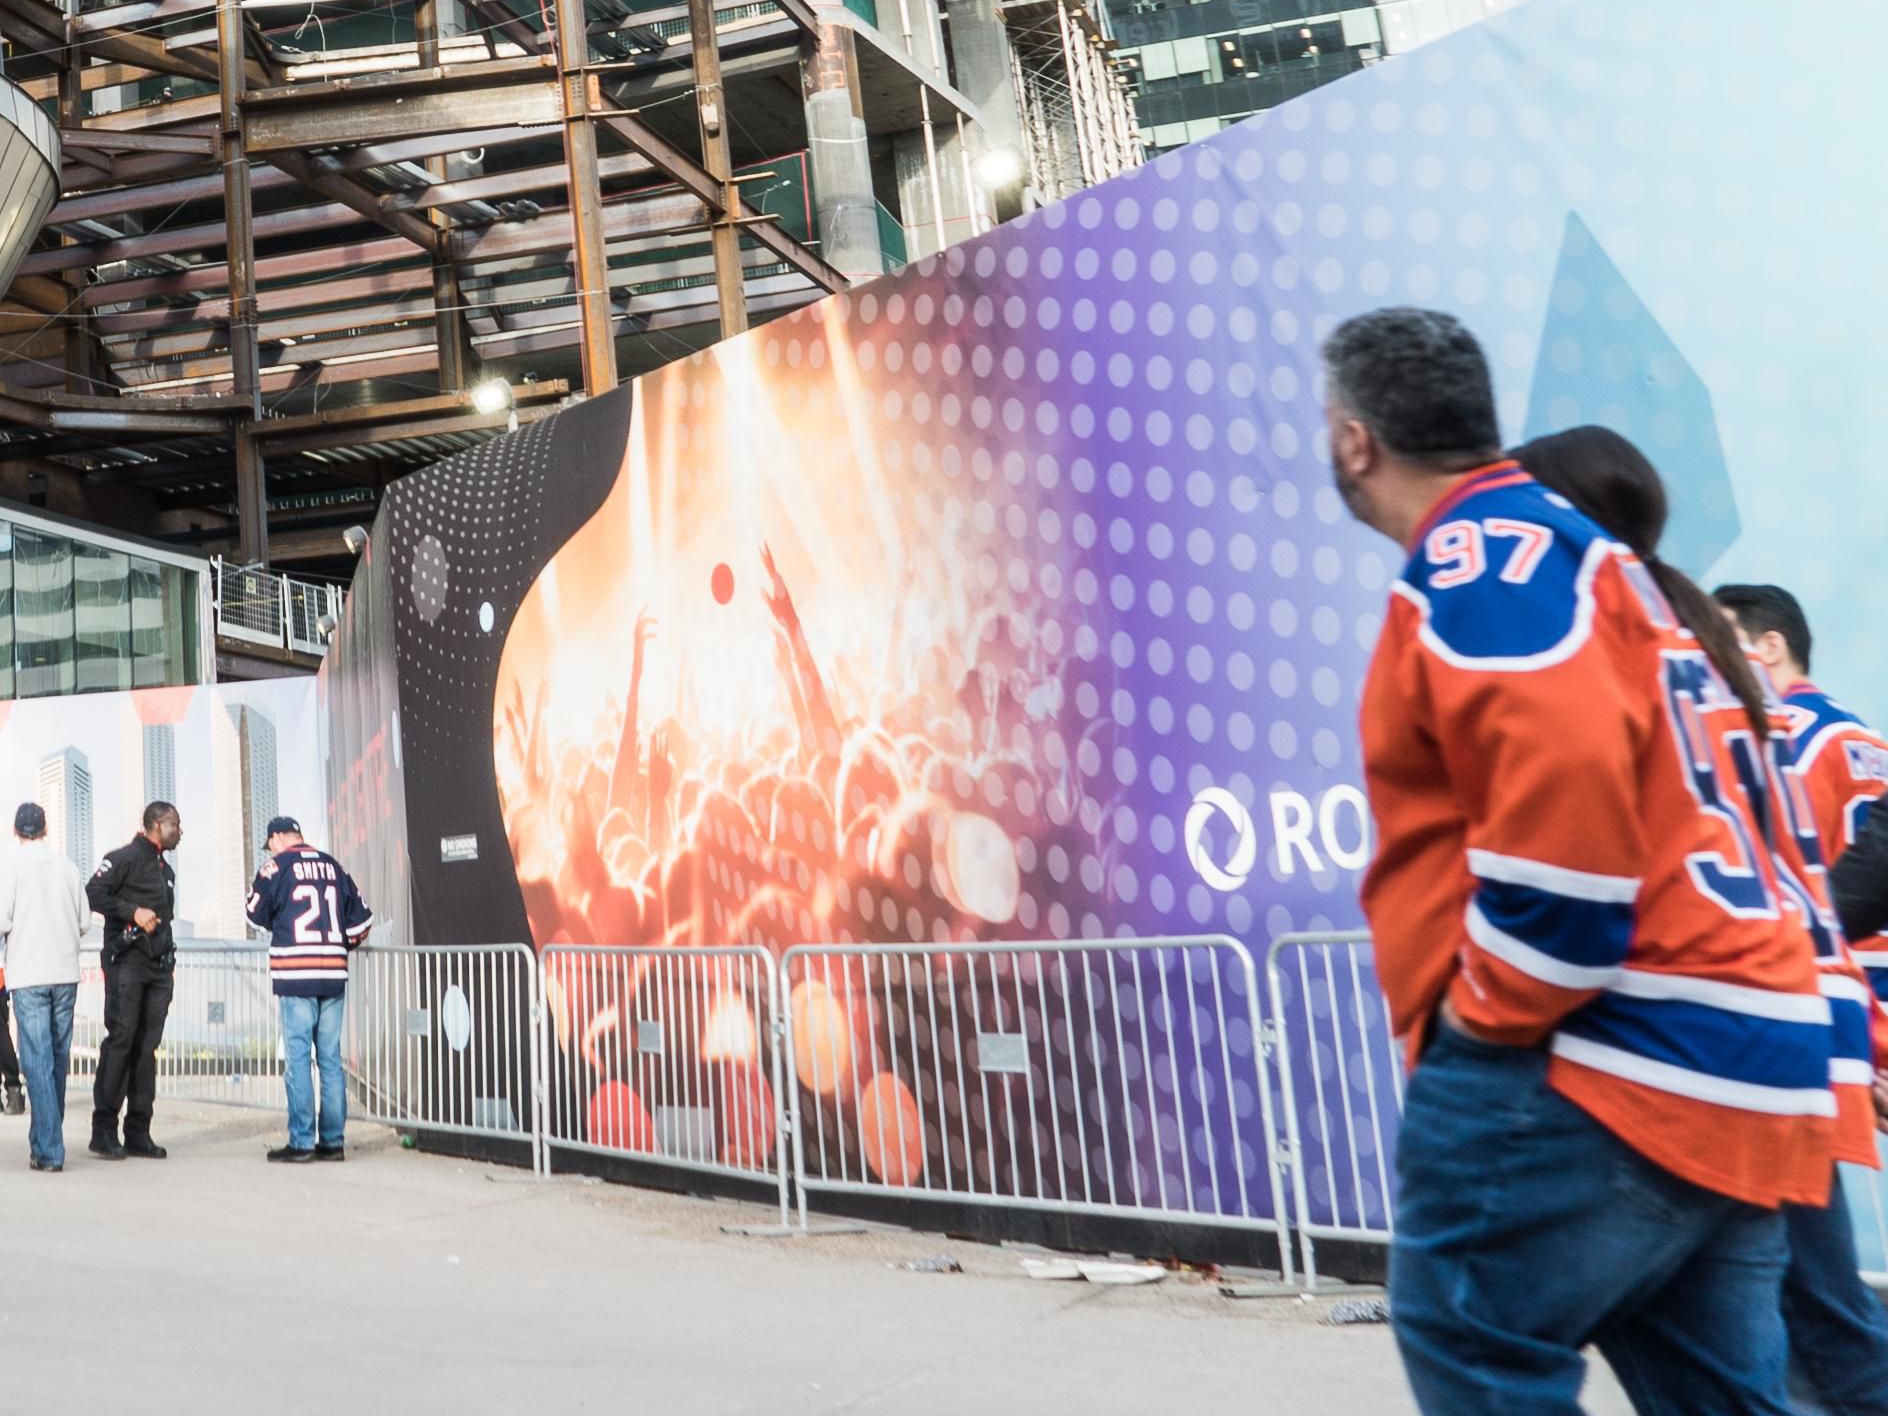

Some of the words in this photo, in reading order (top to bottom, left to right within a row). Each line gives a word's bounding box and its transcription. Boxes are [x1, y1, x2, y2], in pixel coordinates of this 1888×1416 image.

[1425, 518, 1552, 589] 97
[292, 861, 337, 881] SMITH
[292, 884, 344, 945] 21
